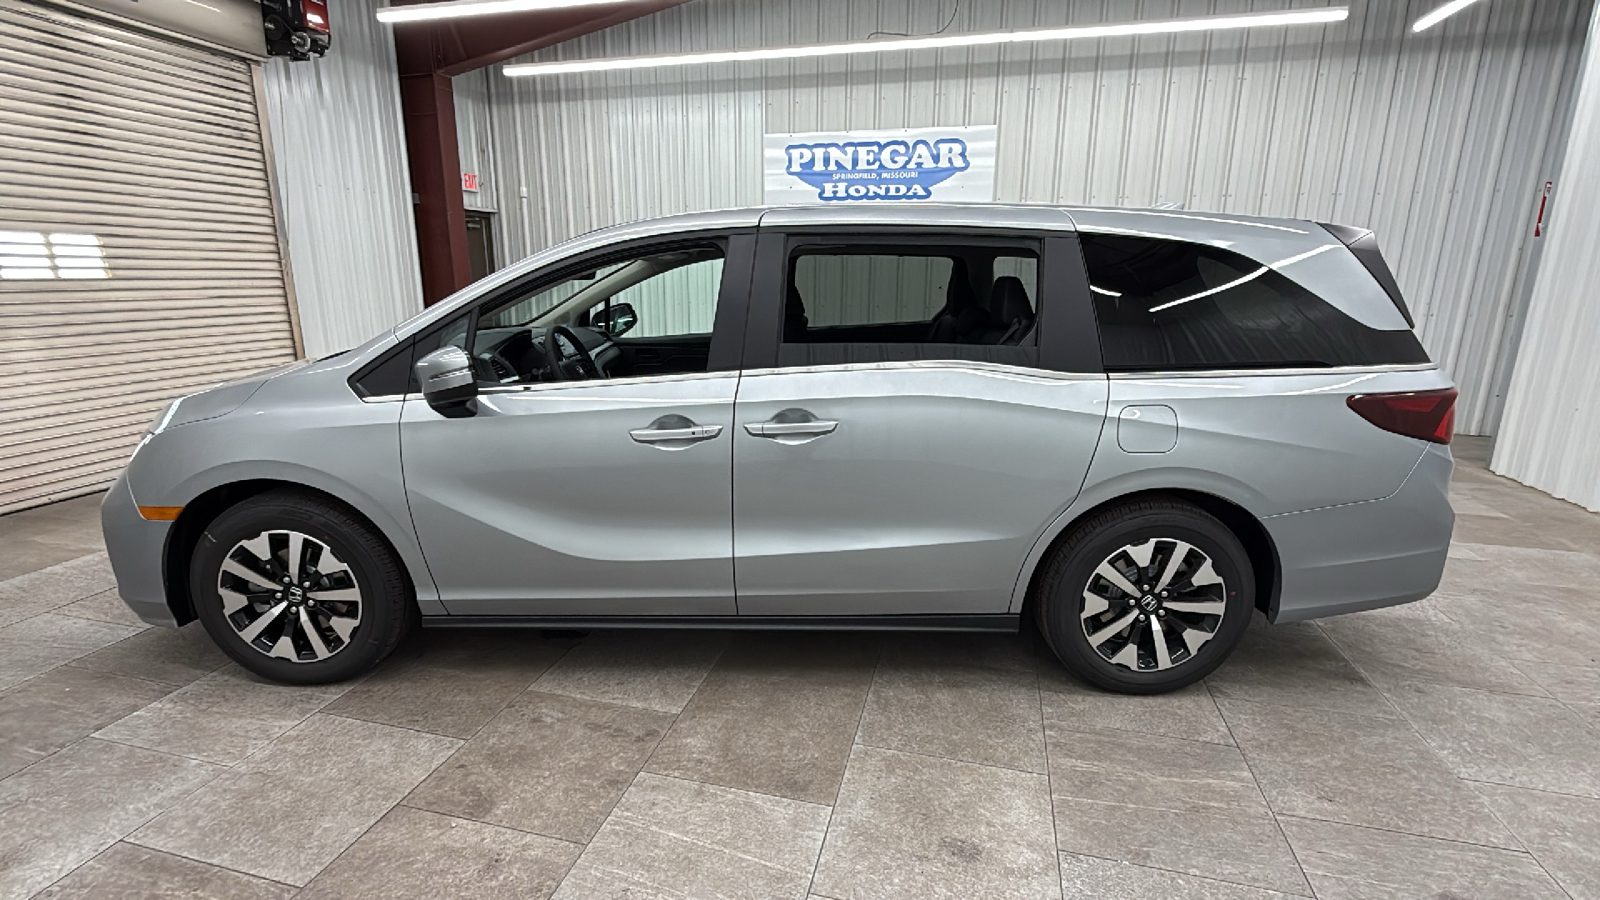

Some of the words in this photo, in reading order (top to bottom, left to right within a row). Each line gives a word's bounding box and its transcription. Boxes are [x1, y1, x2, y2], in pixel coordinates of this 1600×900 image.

[788, 142, 966, 172] PINEGAR
[463, 173, 477, 190] EXIT
[832, 172, 879, 180] SPRINGFIELD,
[881, 171, 918, 179] MISSOURI
[821, 182, 927, 198] HONDA
